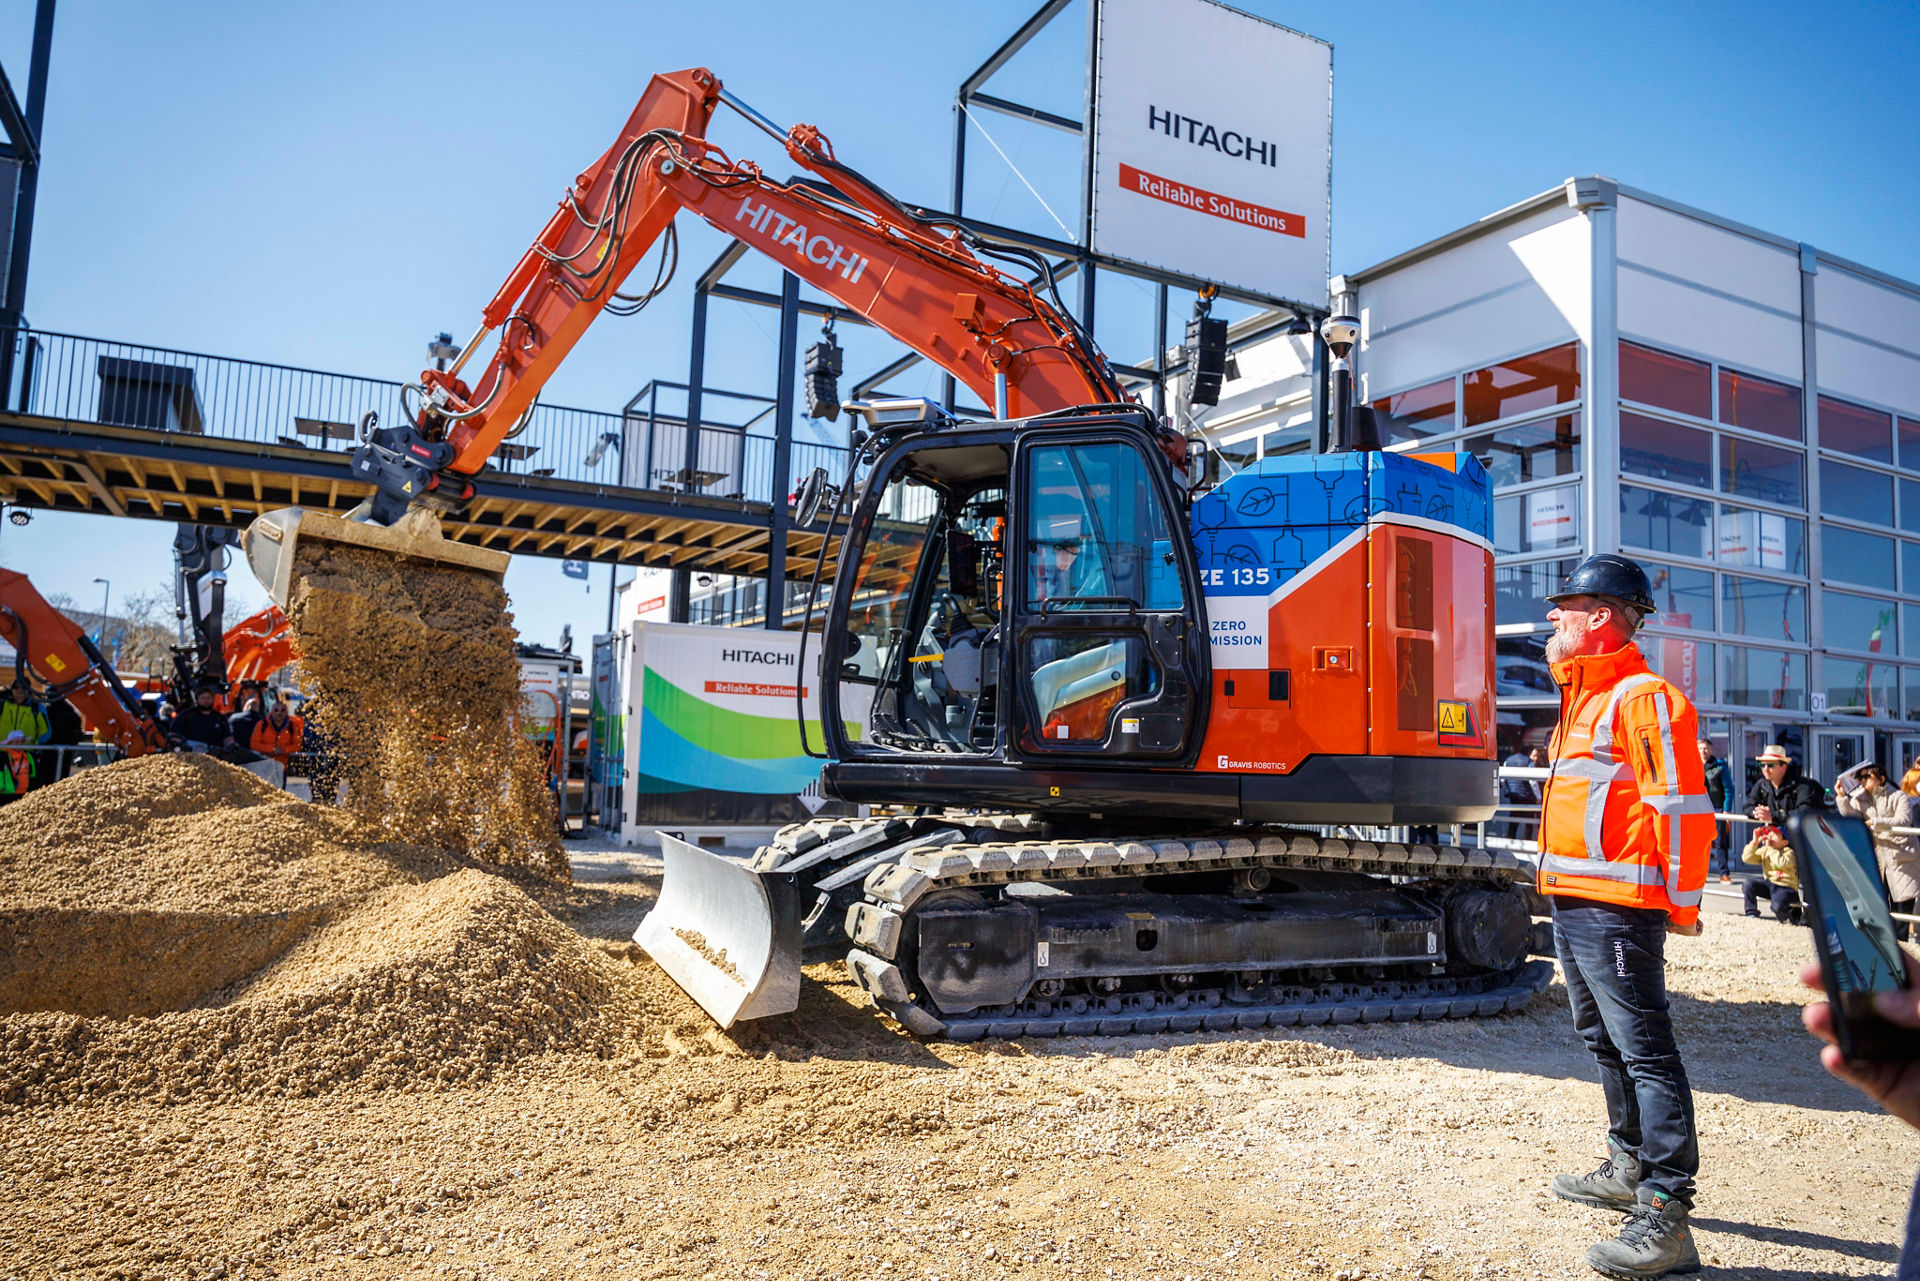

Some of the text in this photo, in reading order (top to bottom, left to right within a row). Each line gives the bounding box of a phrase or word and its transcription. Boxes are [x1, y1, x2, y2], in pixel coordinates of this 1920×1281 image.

[1149, 104, 1277, 168] HITACHI
[1138, 173, 1287, 231] Reliable Solutions
[734, 196, 869, 284] HITACHI
[1199, 567, 1270, 586] ZE 135
[1212, 620, 1247, 631] ZERO
[1209, 635, 1263, 646] MISSION
[722, 648, 795, 666] HITACHI
[715, 682, 753, 694] Reliable
[1812, 696, 1824, 710] 01
[1228, 761, 1253, 769] GRAVIS
[1253, 761, 1286, 770] ROBOTICS
[1613, 941, 1626, 977] HITACHI
